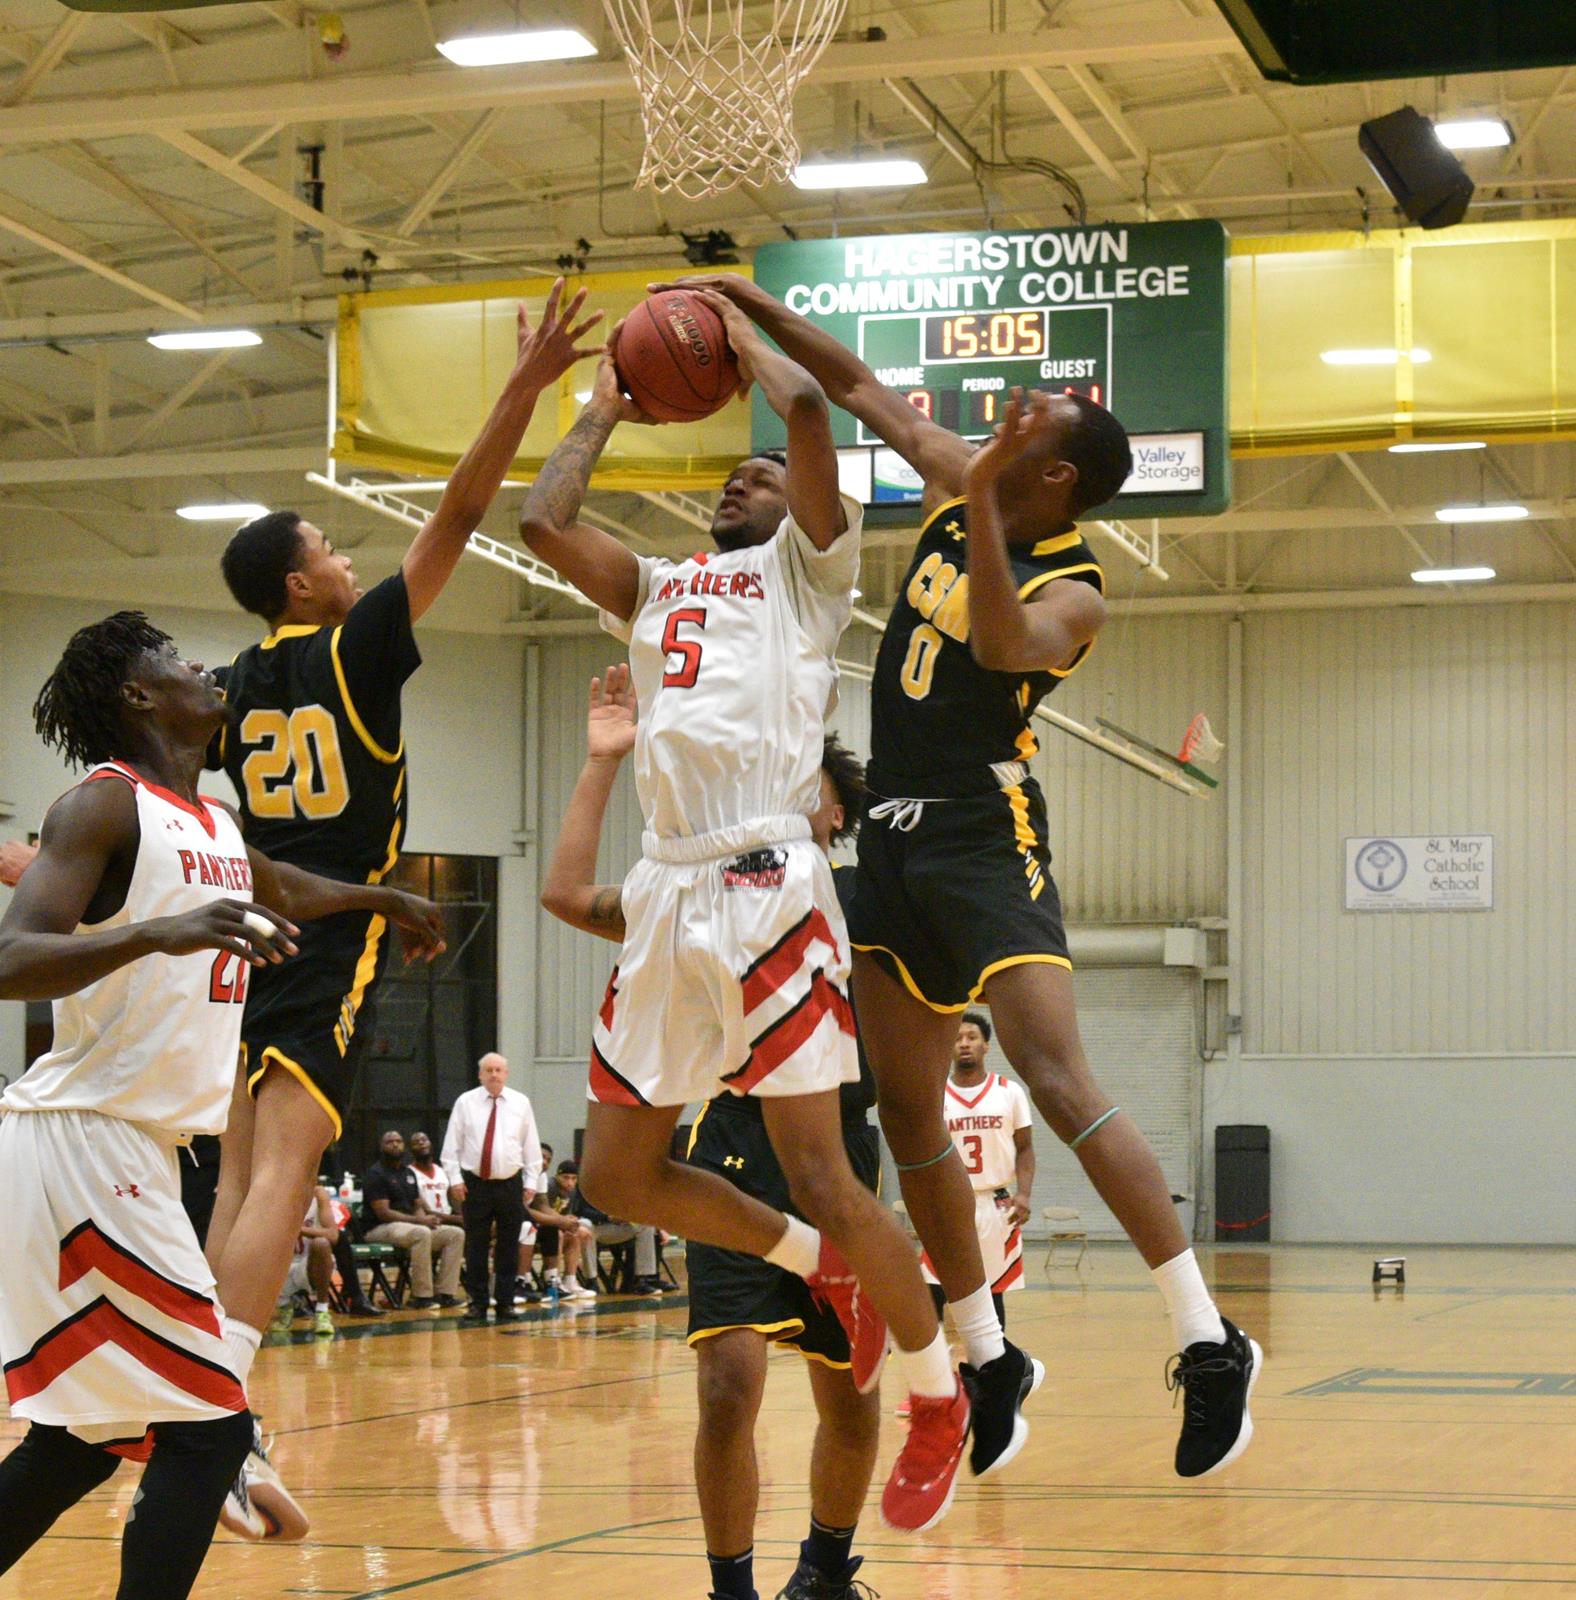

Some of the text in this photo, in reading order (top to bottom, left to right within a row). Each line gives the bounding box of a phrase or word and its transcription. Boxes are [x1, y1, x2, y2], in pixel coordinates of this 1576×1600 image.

[844, 230, 1129, 278] HAGERSTOWN
[784, 265, 1190, 316] COMMUNITY COLLEGE
[942, 313, 1042, 357] 15:05
[875, 367, 925, 386] HOME
[1040, 359, 1097, 379] GUEST
[962, 377, 1006, 392] PERIOD
[983, 393, 995, 422] 1
[1138, 446, 1186, 466] Valley
[1137, 464, 1201, 481] Storage
[660, 607, 707, 689] 5
[900, 622, 943, 701] 0
[240, 703, 350, 820] 20
[1449, 838, 1483, 858] Mary
[1423, 857, 1485, 873] Catholic
[1429, 875, 1480, 891] School
[963, 1135, 983, 1174] 3
